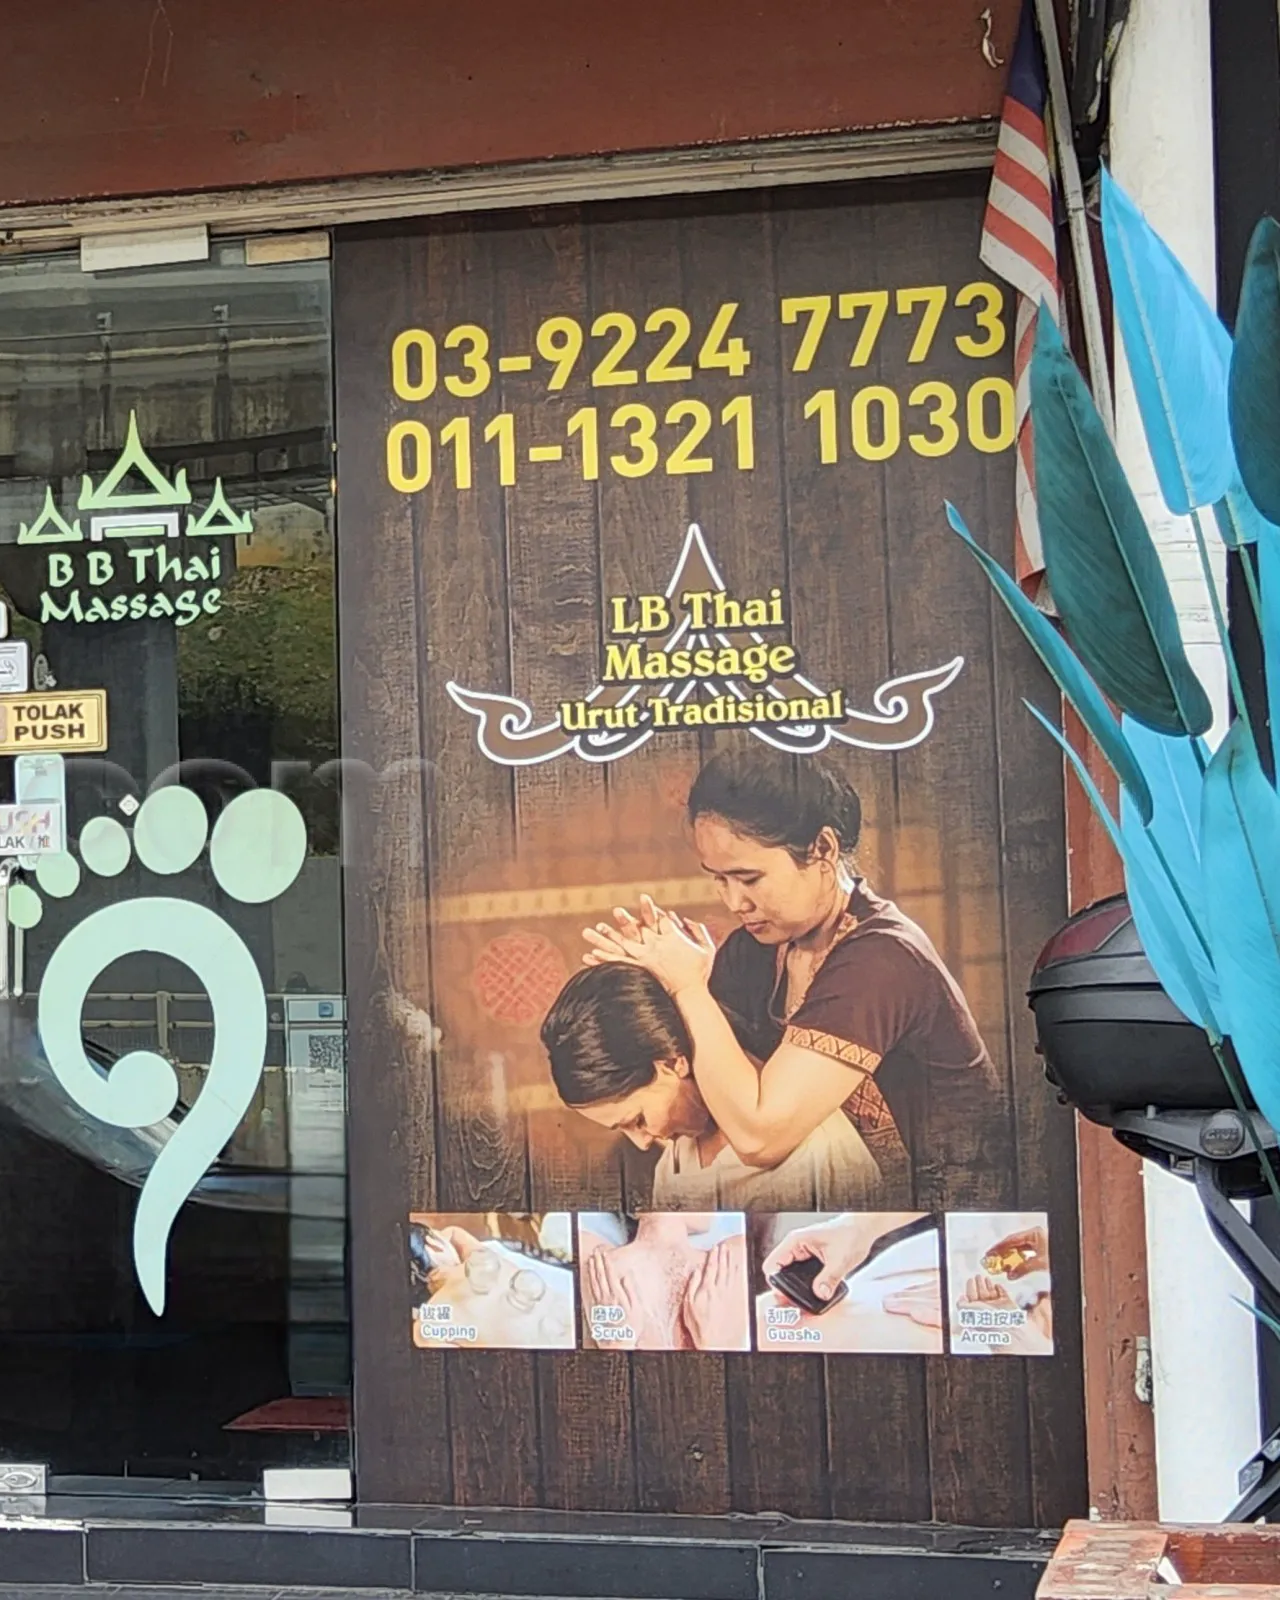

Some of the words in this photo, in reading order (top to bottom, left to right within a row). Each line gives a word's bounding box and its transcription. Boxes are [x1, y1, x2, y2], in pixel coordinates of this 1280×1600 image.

[391, 302, 750, 402] 03-9224
[780, 281, 1006, 372] 7773
[386, 395, 755, 494] 011-1321
[804, 376, 1017, 465] 1030
[127, 545, 221, 584] Thai
[40, 588, 222, 626] Massage
[611, 597, 669, 633] LB
[684, 589, 784, 630] Thai
[602, 643, 796, 682] Massage
[13, 703, 83, 721] TOLAK
[560, 702, 640, 731] Urut
[648, 691, 844, 728] Tradisional
[14, 723, 85, 741] PUSH
[423, 1325, 476, 1339] Cupping
[593, 1325, 633, 1339] Scrub
[768, 1328, 821, 1341] Guasha
[961, 1331, 1010, 1344] Aroma
